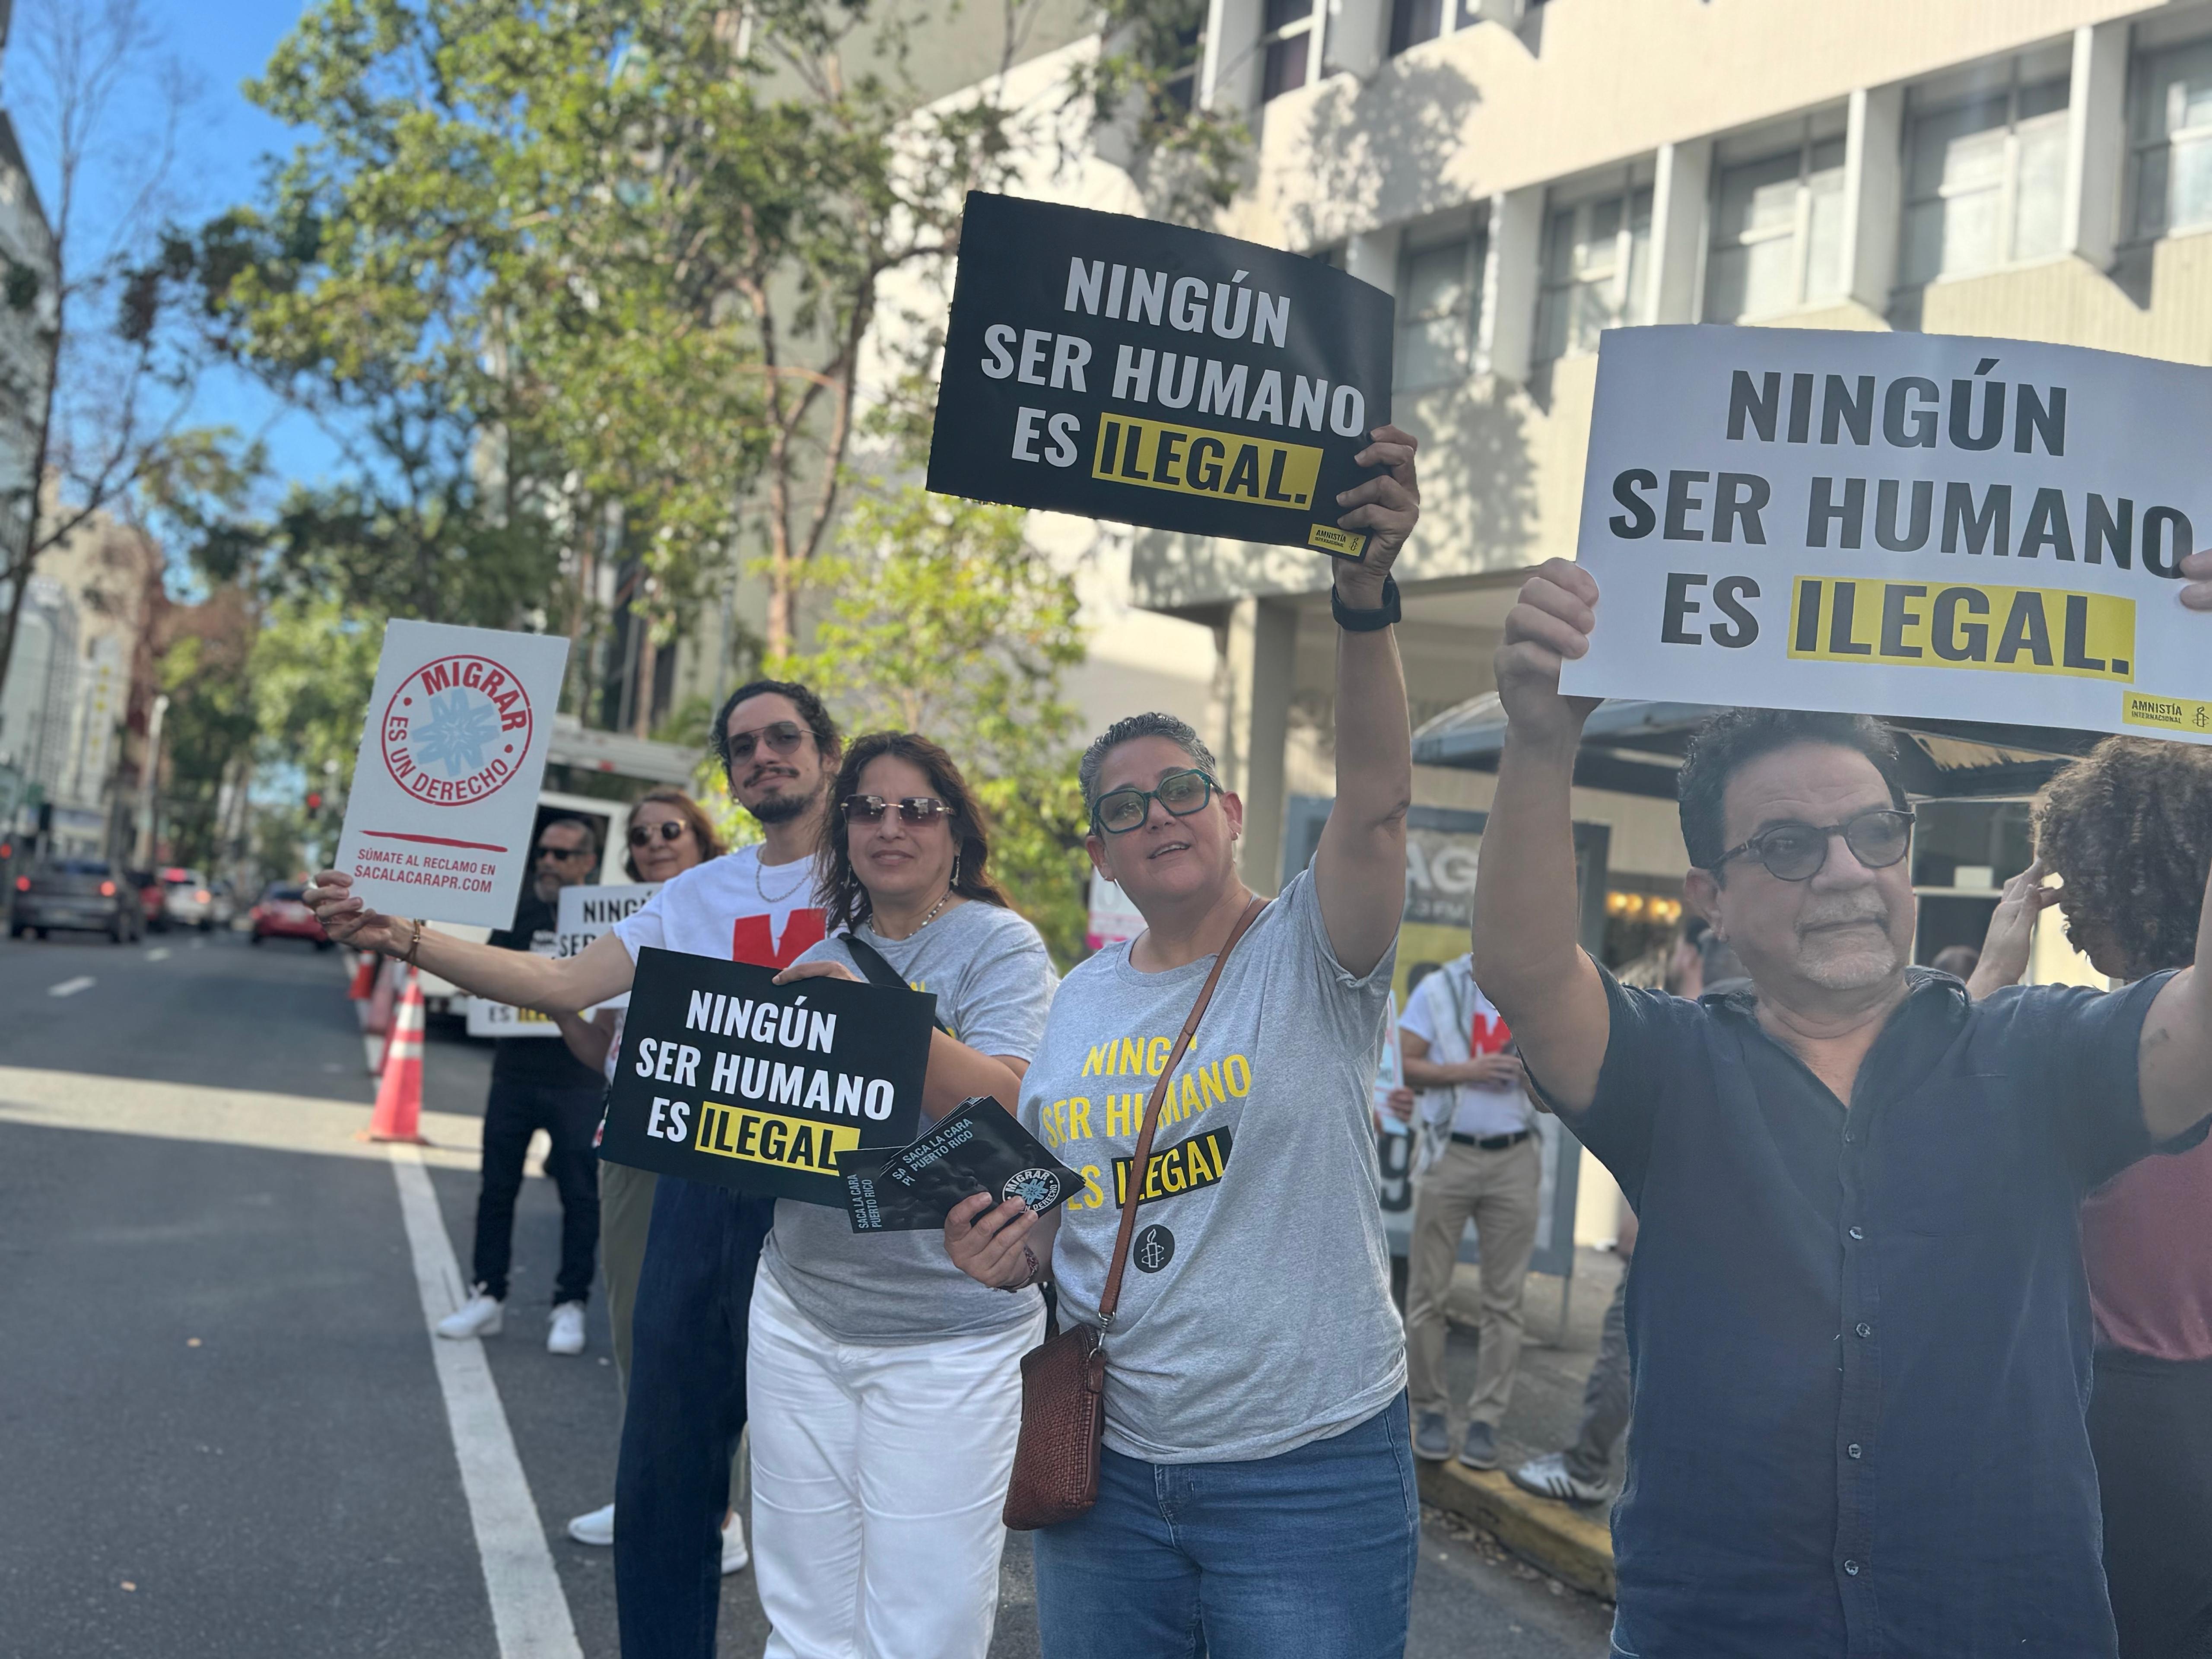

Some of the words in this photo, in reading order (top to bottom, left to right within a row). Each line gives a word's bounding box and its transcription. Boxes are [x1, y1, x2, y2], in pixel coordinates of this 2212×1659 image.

[1064, 256, 1290, 349] NINGÚN
[981, 324, 1093, 393] SER
[1111, 344, 1365, 437] HUMANO
[1726, 358, 2067, 457] NINGÚN
[1011, 406, 1080, 467] ES
[1099, 421, 1312, 505] ILEGAL.
[1316, 529, 1346, 543] AMNISTÍA
[1608, 468, 1770, 546] SER
[1805, 477, 2193, 580] HUMANO
[1661, 572, 1761, 648] ES
[1794, 580, 2130, 675] ILEGAL.
[421, 661, 528, 732] MIGRAR
[2132, 699, 2182, 715] AMNISTÍA
[388, 716, 408, 742] ES
[391, 748, 417, 779] UN
[412, 758, 509, 801] DERECHO
[354, 865, 493, 893] SACALACARAPR.COM
[358, 847, 404, 865] SÚMATE
[406, 855, 420, 867] AL
[423, 856, 477, 872] RECLAMO
[480, 863, 496, 876] EN
[686, 990, 837, 1054] NINGÚN
[636, 1037, 701, 1087] SER
[711, 1052, 895, 1121] HUMANO
[647, 1096, 691, 1143] ES
[903, 1144, 931, 1163] SACA
[929, 1135, 945, 1147] LA
[944, 1118, 973, 1138] CARA
[910, 1146, 949, 1172] PUERTO
[947, 1130, 973, 1149] RICO
[847, 1174, 861, 1195] CARA
[861, 1179, 875, 1198] RICO
[1005, 1170, 1050, 1192] MIGRAR
[1033, 1184, 1058, 1211] DERECHO
[852, 1196, 864, 1206] LA
[855, 1209, 869, 1228] SACA
[867, 1199, 882, 1227] PUERTO
